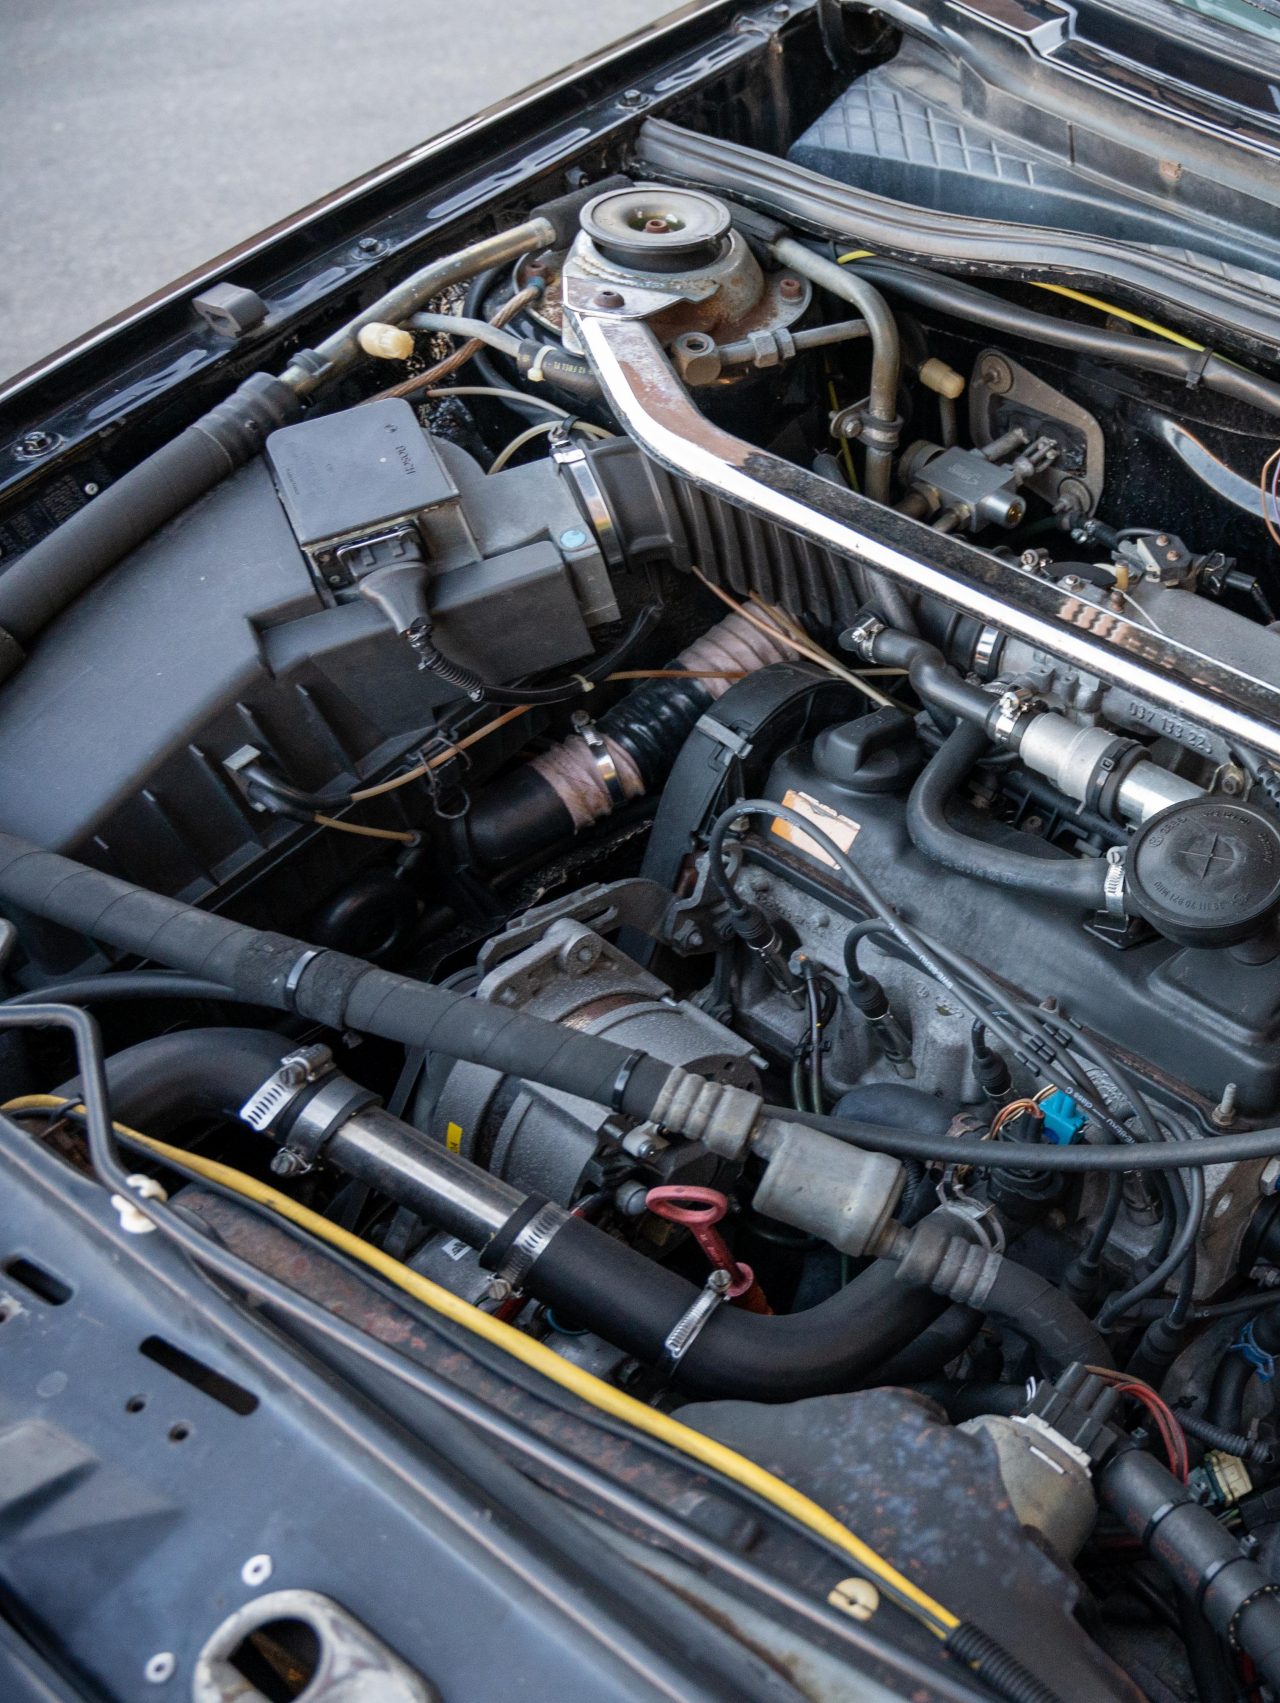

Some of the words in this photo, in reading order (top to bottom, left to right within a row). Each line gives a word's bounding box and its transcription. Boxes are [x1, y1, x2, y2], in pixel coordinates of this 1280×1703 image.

[395, 445, 416, 475] BOSCH
[1161, 716, 1184, 739] 133
[1065, 1086, 1074, 1094] C
[1073, 1092, 1093, 1109] class
